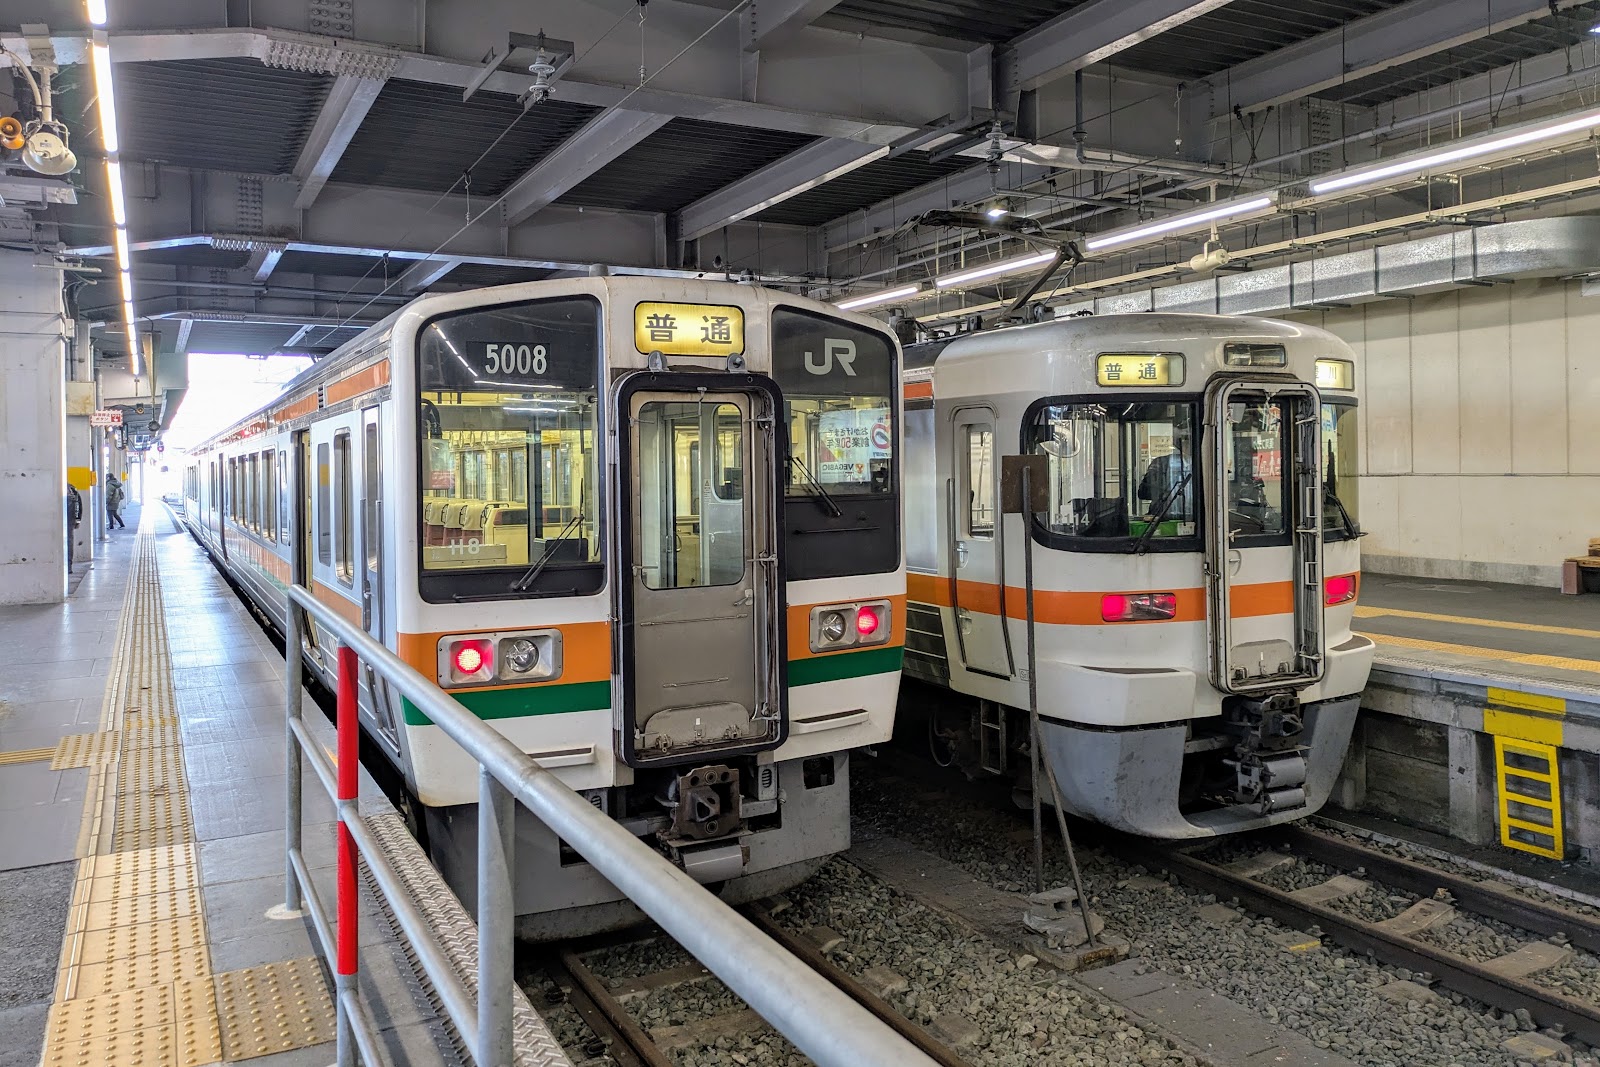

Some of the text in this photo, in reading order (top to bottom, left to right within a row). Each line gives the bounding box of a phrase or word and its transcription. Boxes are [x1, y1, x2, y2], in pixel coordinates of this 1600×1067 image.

[645, 313, 732, 344] 普通
[485, 344, 548, 375] 5008
[804, 338, 857, 376] JR
[1104, 362, 1158, 381] 普通
